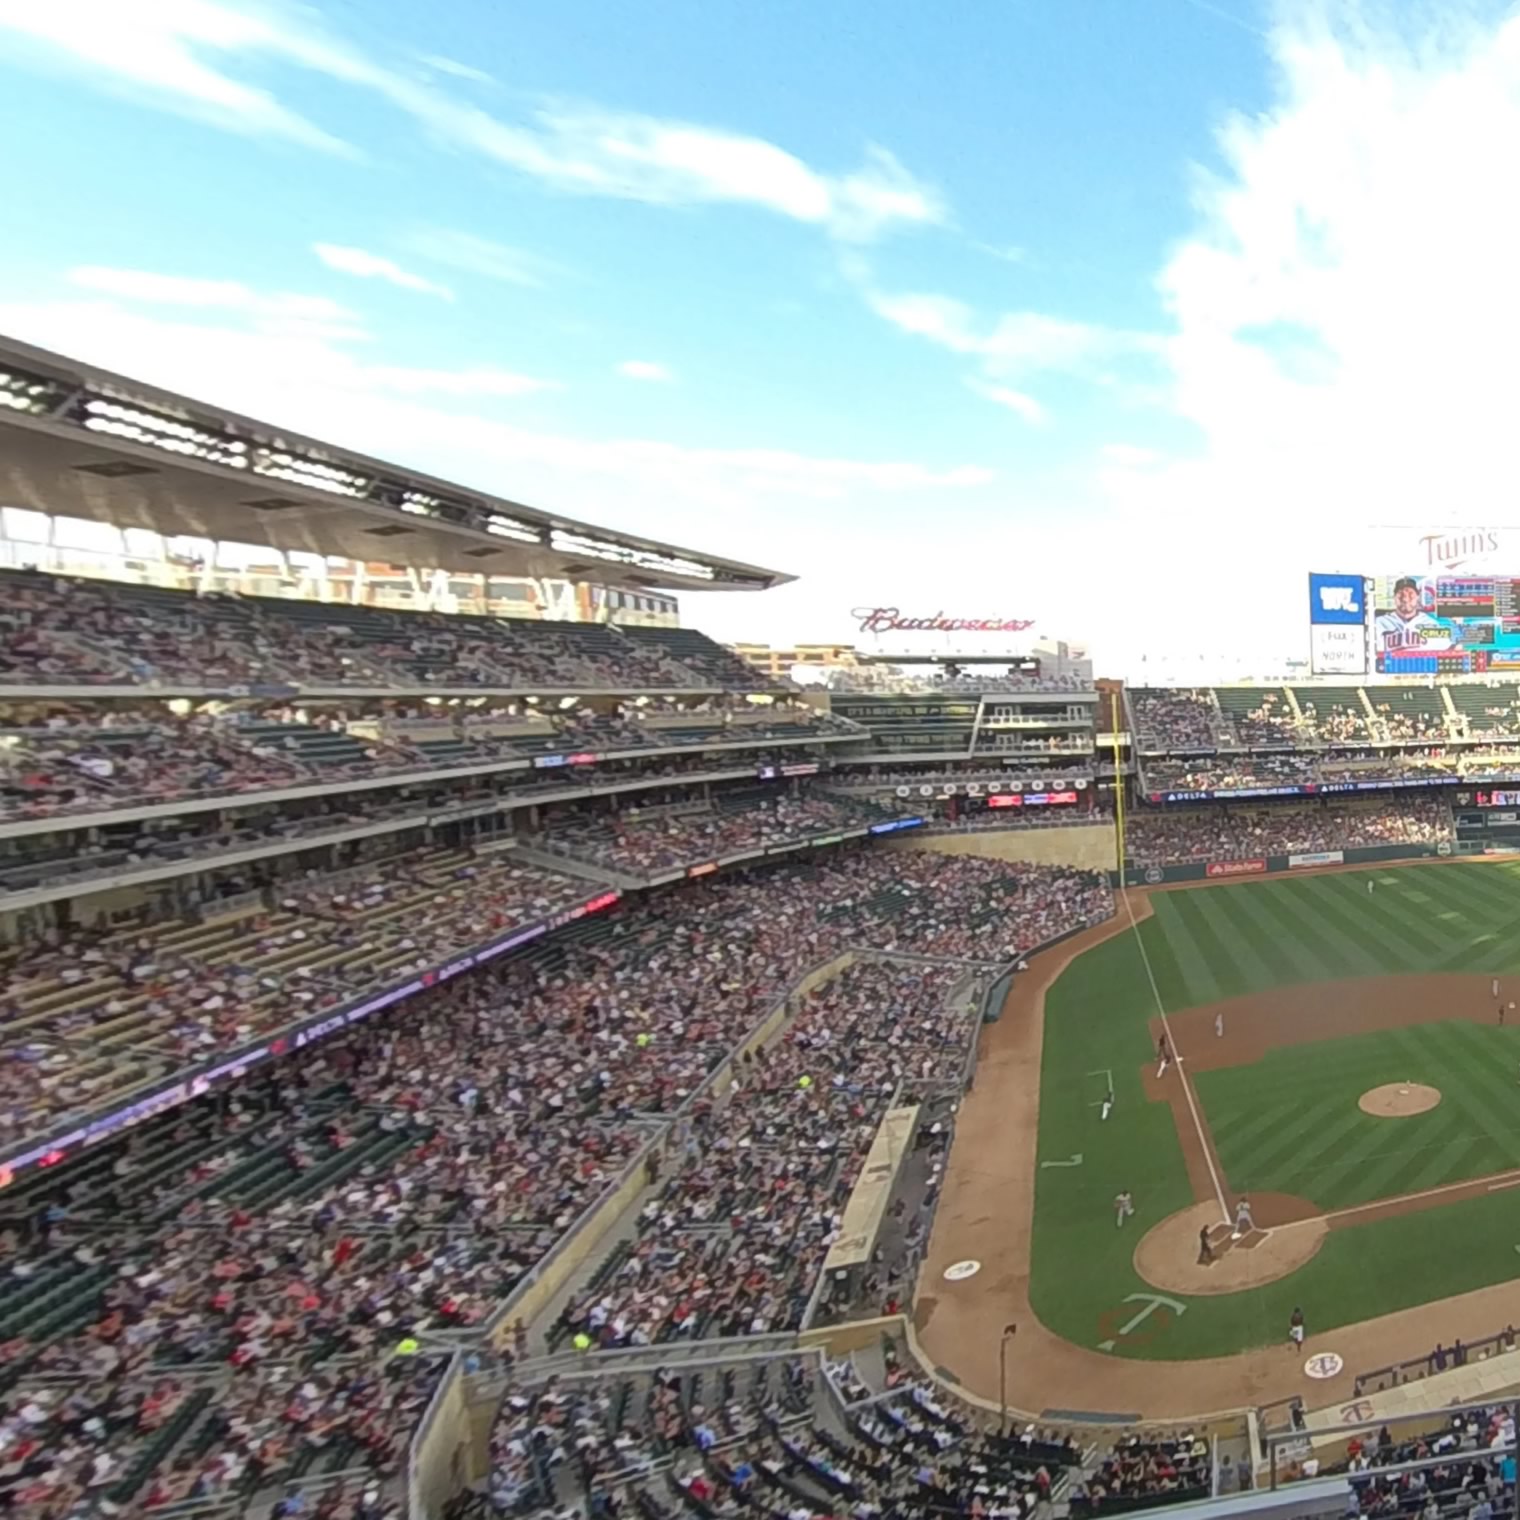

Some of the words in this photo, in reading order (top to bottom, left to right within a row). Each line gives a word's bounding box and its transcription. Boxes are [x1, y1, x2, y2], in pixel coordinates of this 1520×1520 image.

[851, 606, 1035, 634] Budweiser
[1421, 629, 1450, 638] CRUZ
[1328, 783, 1354, 792] DELTA
[1177, 791, 1207, 800] DELTA
